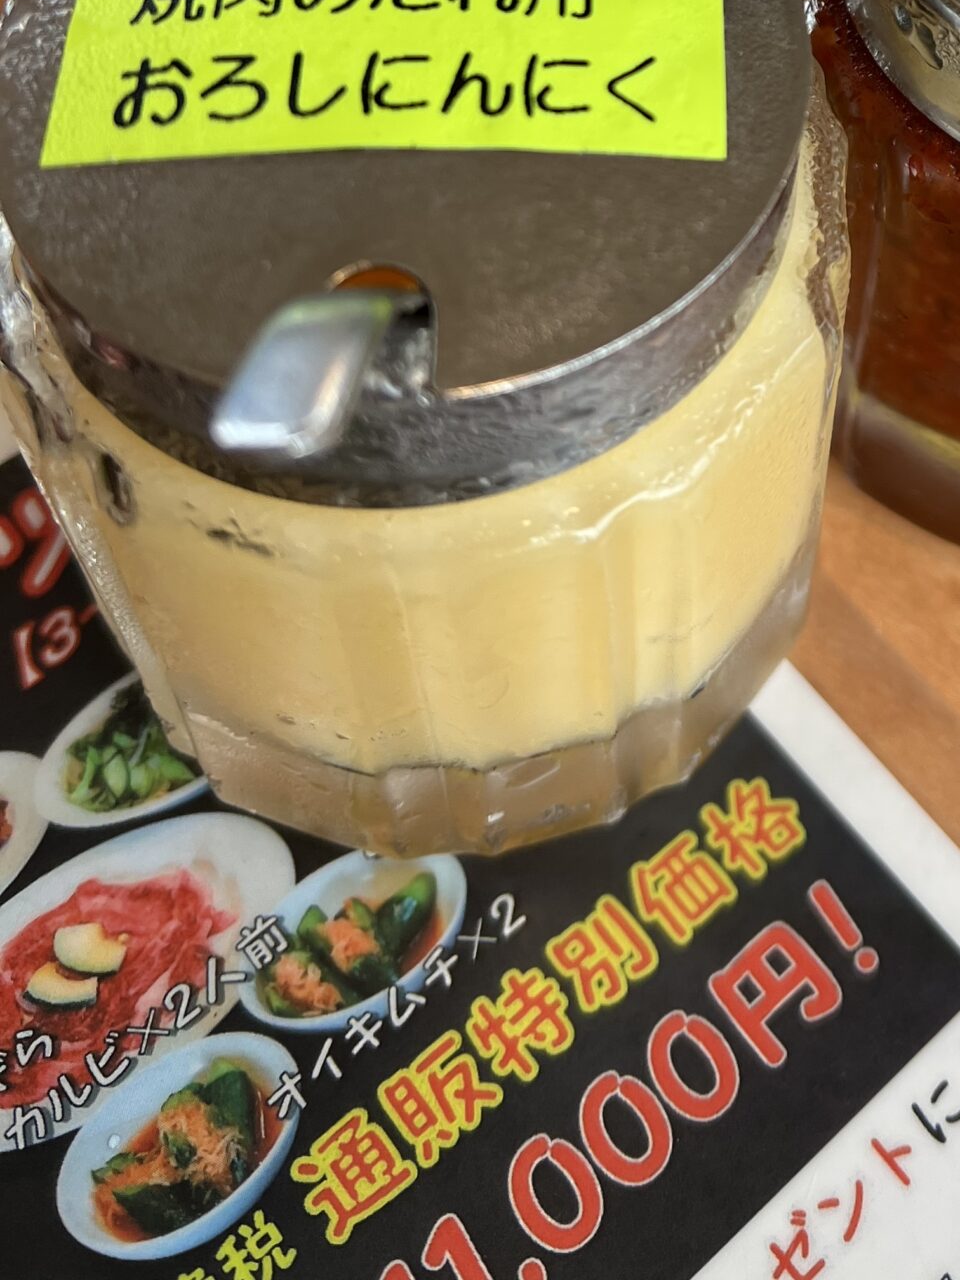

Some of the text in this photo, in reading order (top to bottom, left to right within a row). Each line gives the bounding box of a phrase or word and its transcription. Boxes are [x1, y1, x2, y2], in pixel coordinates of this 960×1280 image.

[112, 50, 657, 129] おろしにんにく
[290, 776, 806, 1244] 通販特別価格
